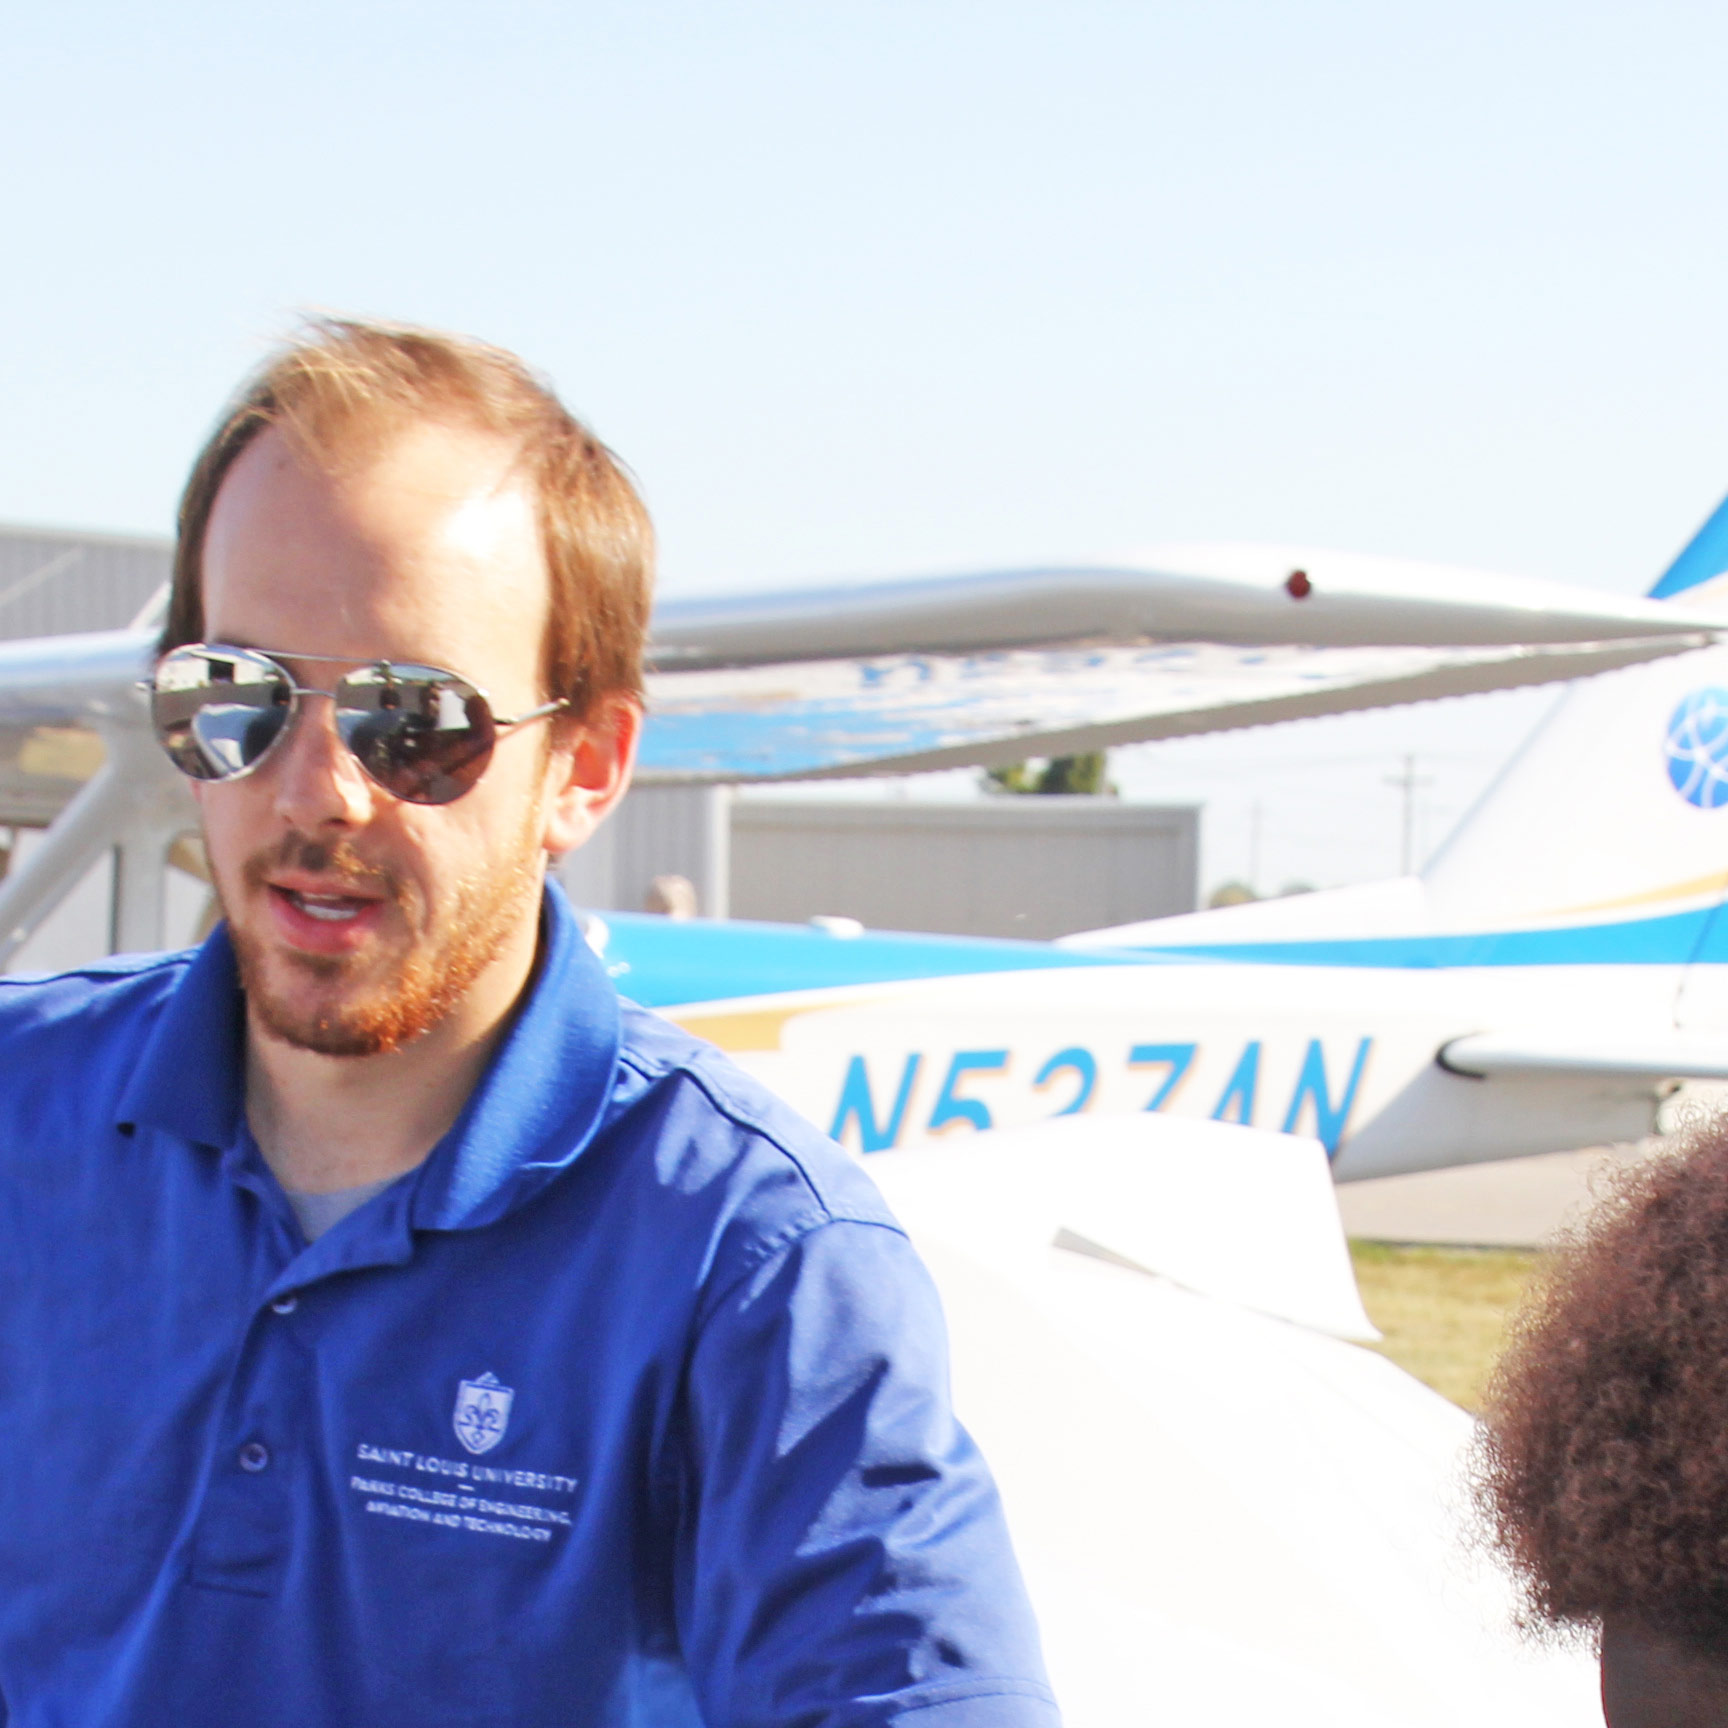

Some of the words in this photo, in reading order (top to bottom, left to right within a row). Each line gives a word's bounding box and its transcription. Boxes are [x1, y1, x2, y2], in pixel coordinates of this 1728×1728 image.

[357, 1443, 414, 1467] SAINT
[415, 1455, 469, 1478] LOUIS
[472, 1465, 578, 1493] UNIVERSITY
[398, 1485, 458, 1508] COLLEGE
[432, 1512, 461, 1528] AND
